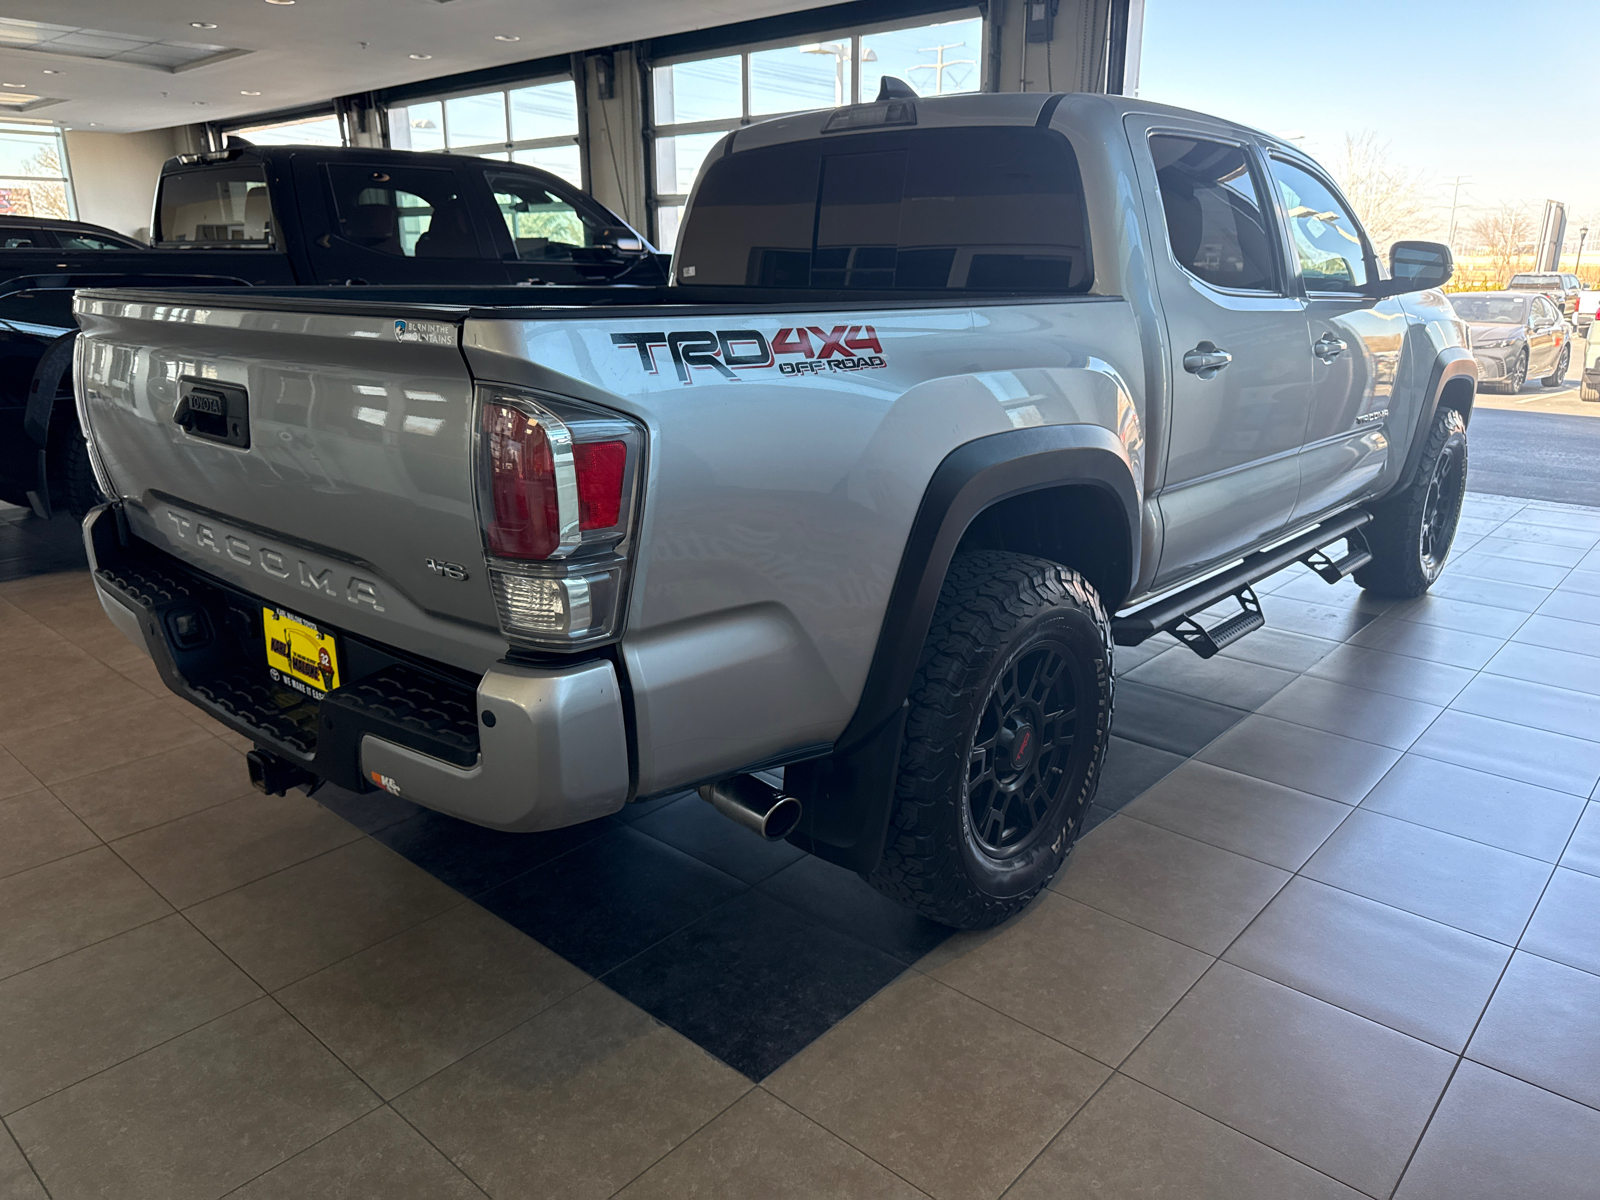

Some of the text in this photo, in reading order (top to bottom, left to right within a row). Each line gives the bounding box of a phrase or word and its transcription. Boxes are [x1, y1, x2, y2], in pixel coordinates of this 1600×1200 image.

[427, 323, 435, 333] IN
[435, 324, 449, 335] THE
[610, 329, 775, 385] TRD
[778, 355, 888, 378] OFF ROAD
[190, 394, 219, 413] TOYOTA
[167, 510, 385, 612] TACOMA
[425, 557, 469, 582] V6
[320, 652, 330, 667] 32
[282, 674, 292, 687] WE
[291, 679, 306, 694] MAKE
[305, 685, 312, 697] IT
[1015, 732, 1030, 762] TRD
[1051, 816, 1076, 855] T/A
